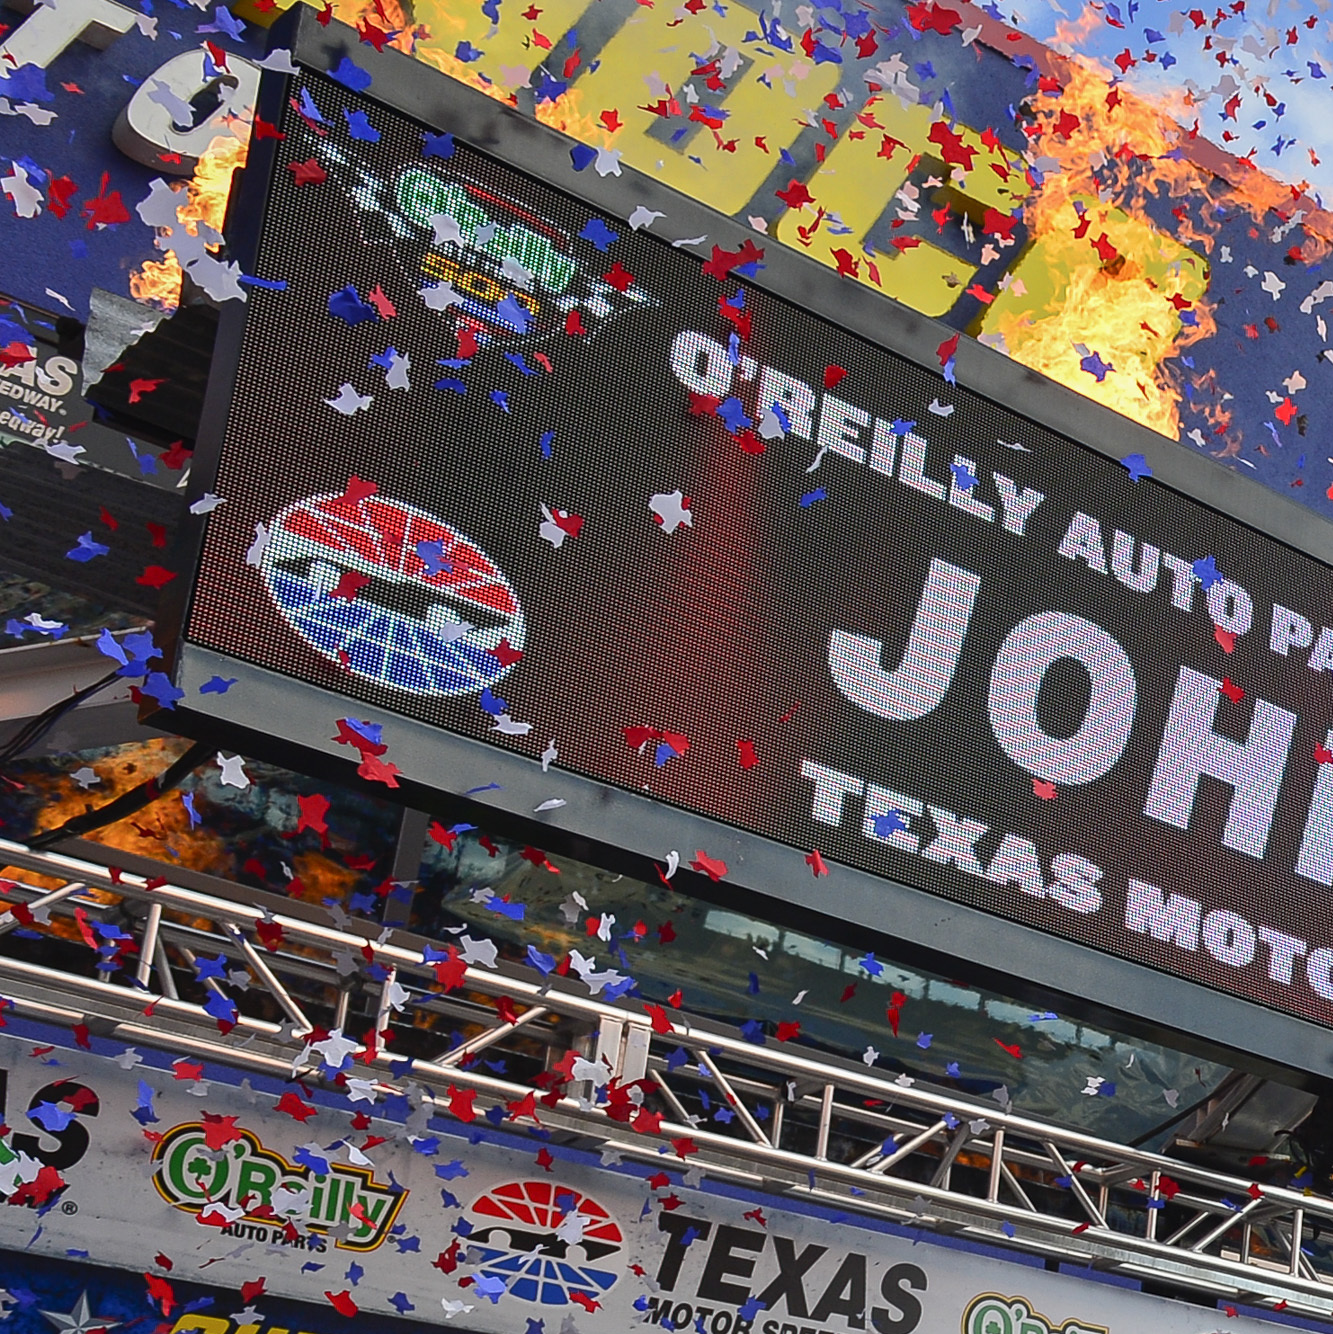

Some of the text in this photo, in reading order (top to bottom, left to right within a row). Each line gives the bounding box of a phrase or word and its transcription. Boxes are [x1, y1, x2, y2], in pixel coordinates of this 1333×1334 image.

[0, 379, 63, 414] EDWAY
[669, 330, 1044, 535] O'REILLY
[1058, 511, 1254, 635] AUTO
[800, 760, 1104, 913] TEXAS
[220, 1223, 328, 1254] AUTO PARTS
